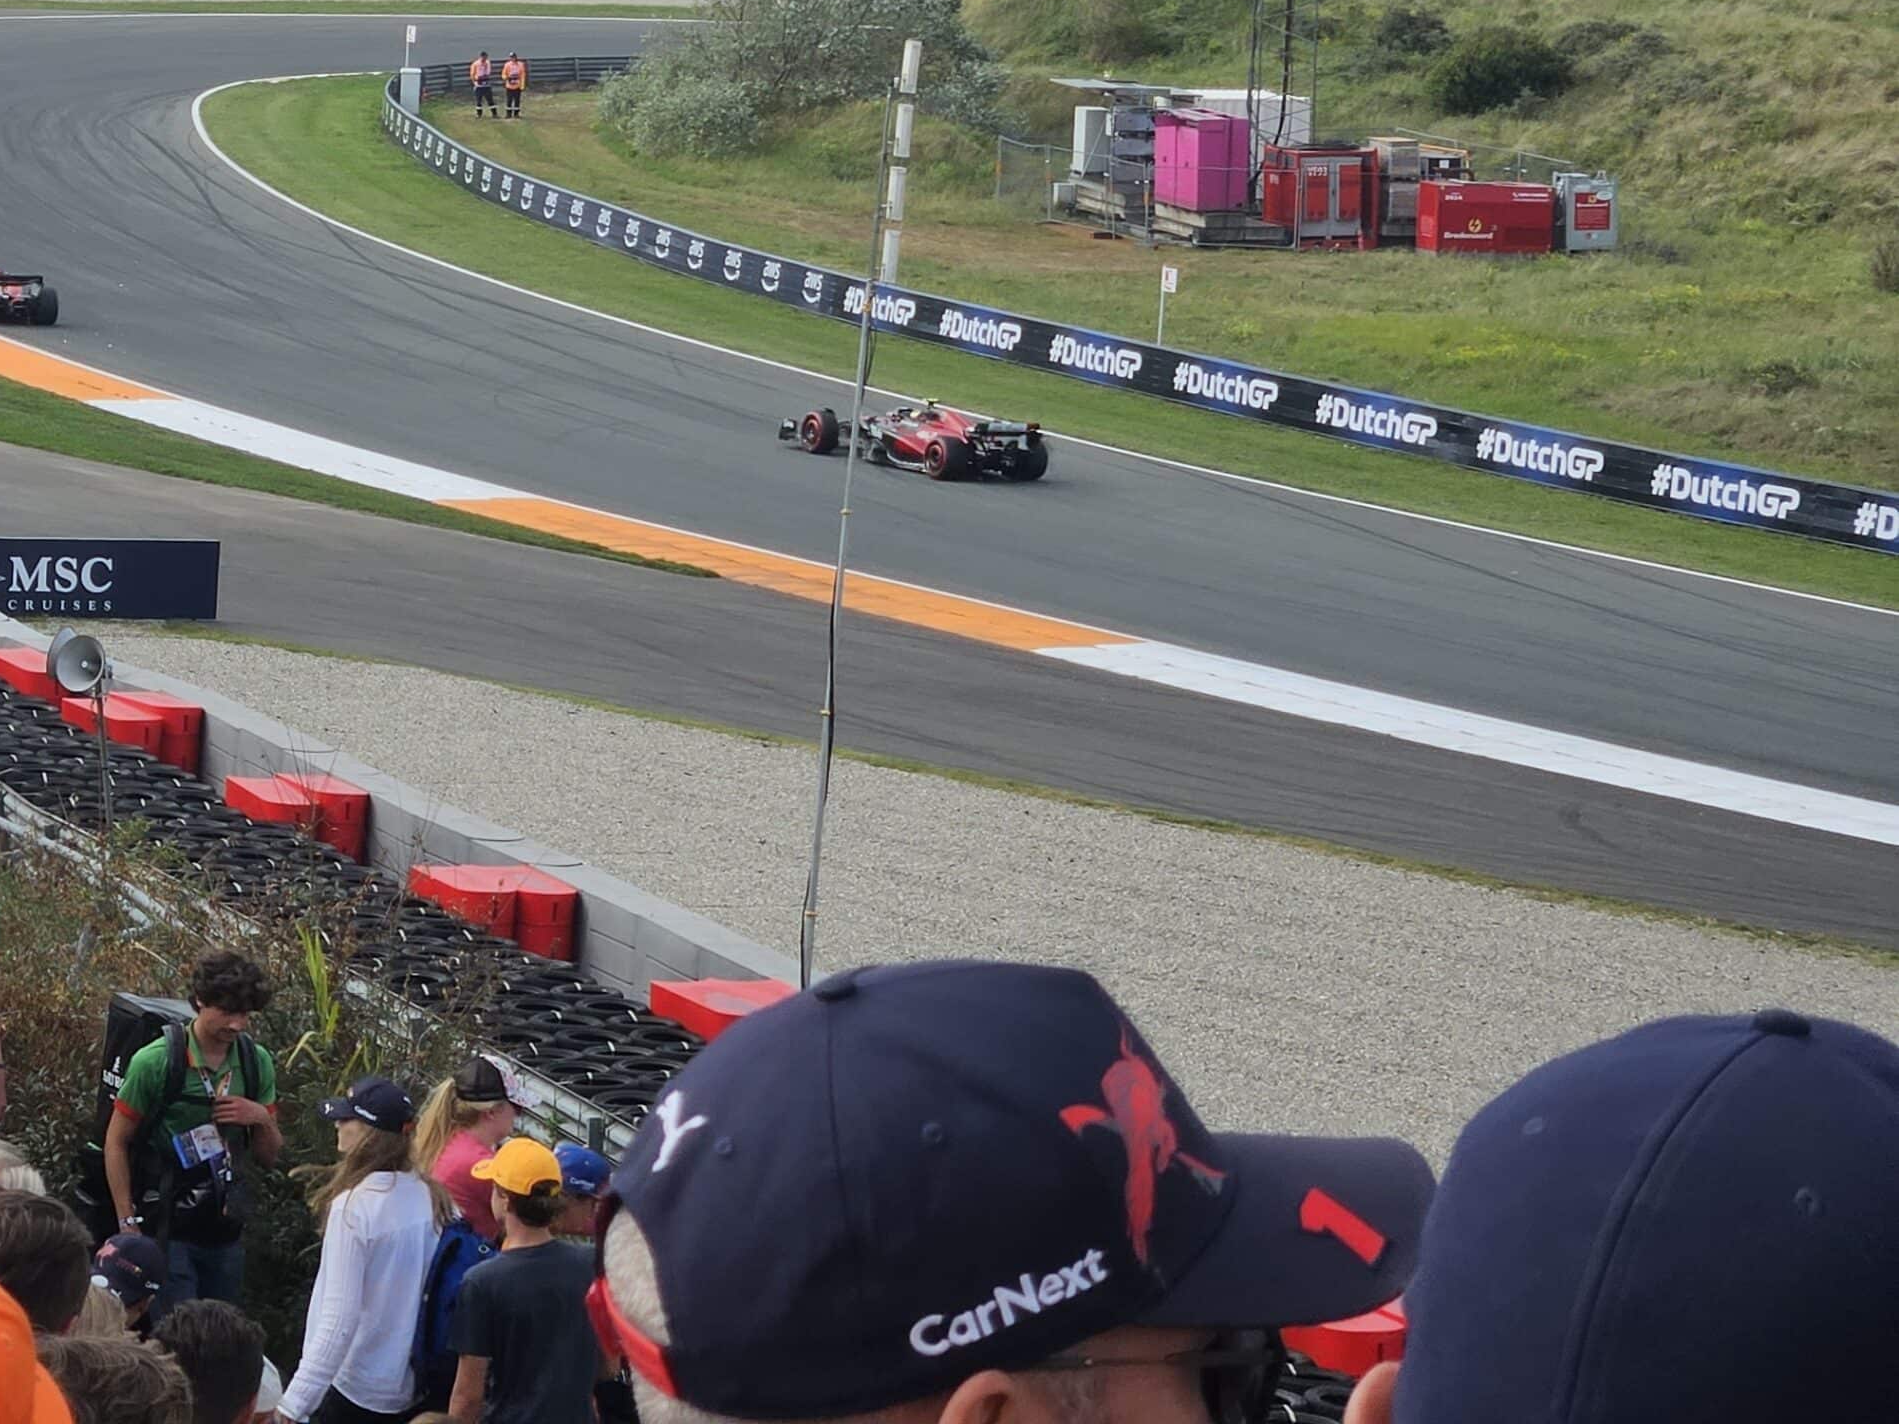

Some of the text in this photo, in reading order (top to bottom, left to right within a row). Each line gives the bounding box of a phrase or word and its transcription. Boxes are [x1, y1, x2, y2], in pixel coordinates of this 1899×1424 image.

[939, 309, 1022, 351] #DutchGP
[1048, 334, 1142, 380] #DutchGP
[1173, 362, 1279, 411] #DutchGP
[1315, 393, 1438, 446] #DutchGP
[1476, 427, 1604, 481] #DutchGP
[1649, 463, 1800, 520] #DutchGP
[8, 556, 113, 593] MSC
[8, 599, 112, 612] CRUISES
[1299, 1187, 1388, 1265] 1
[908, 1249, 1109, 1358] CarNext
